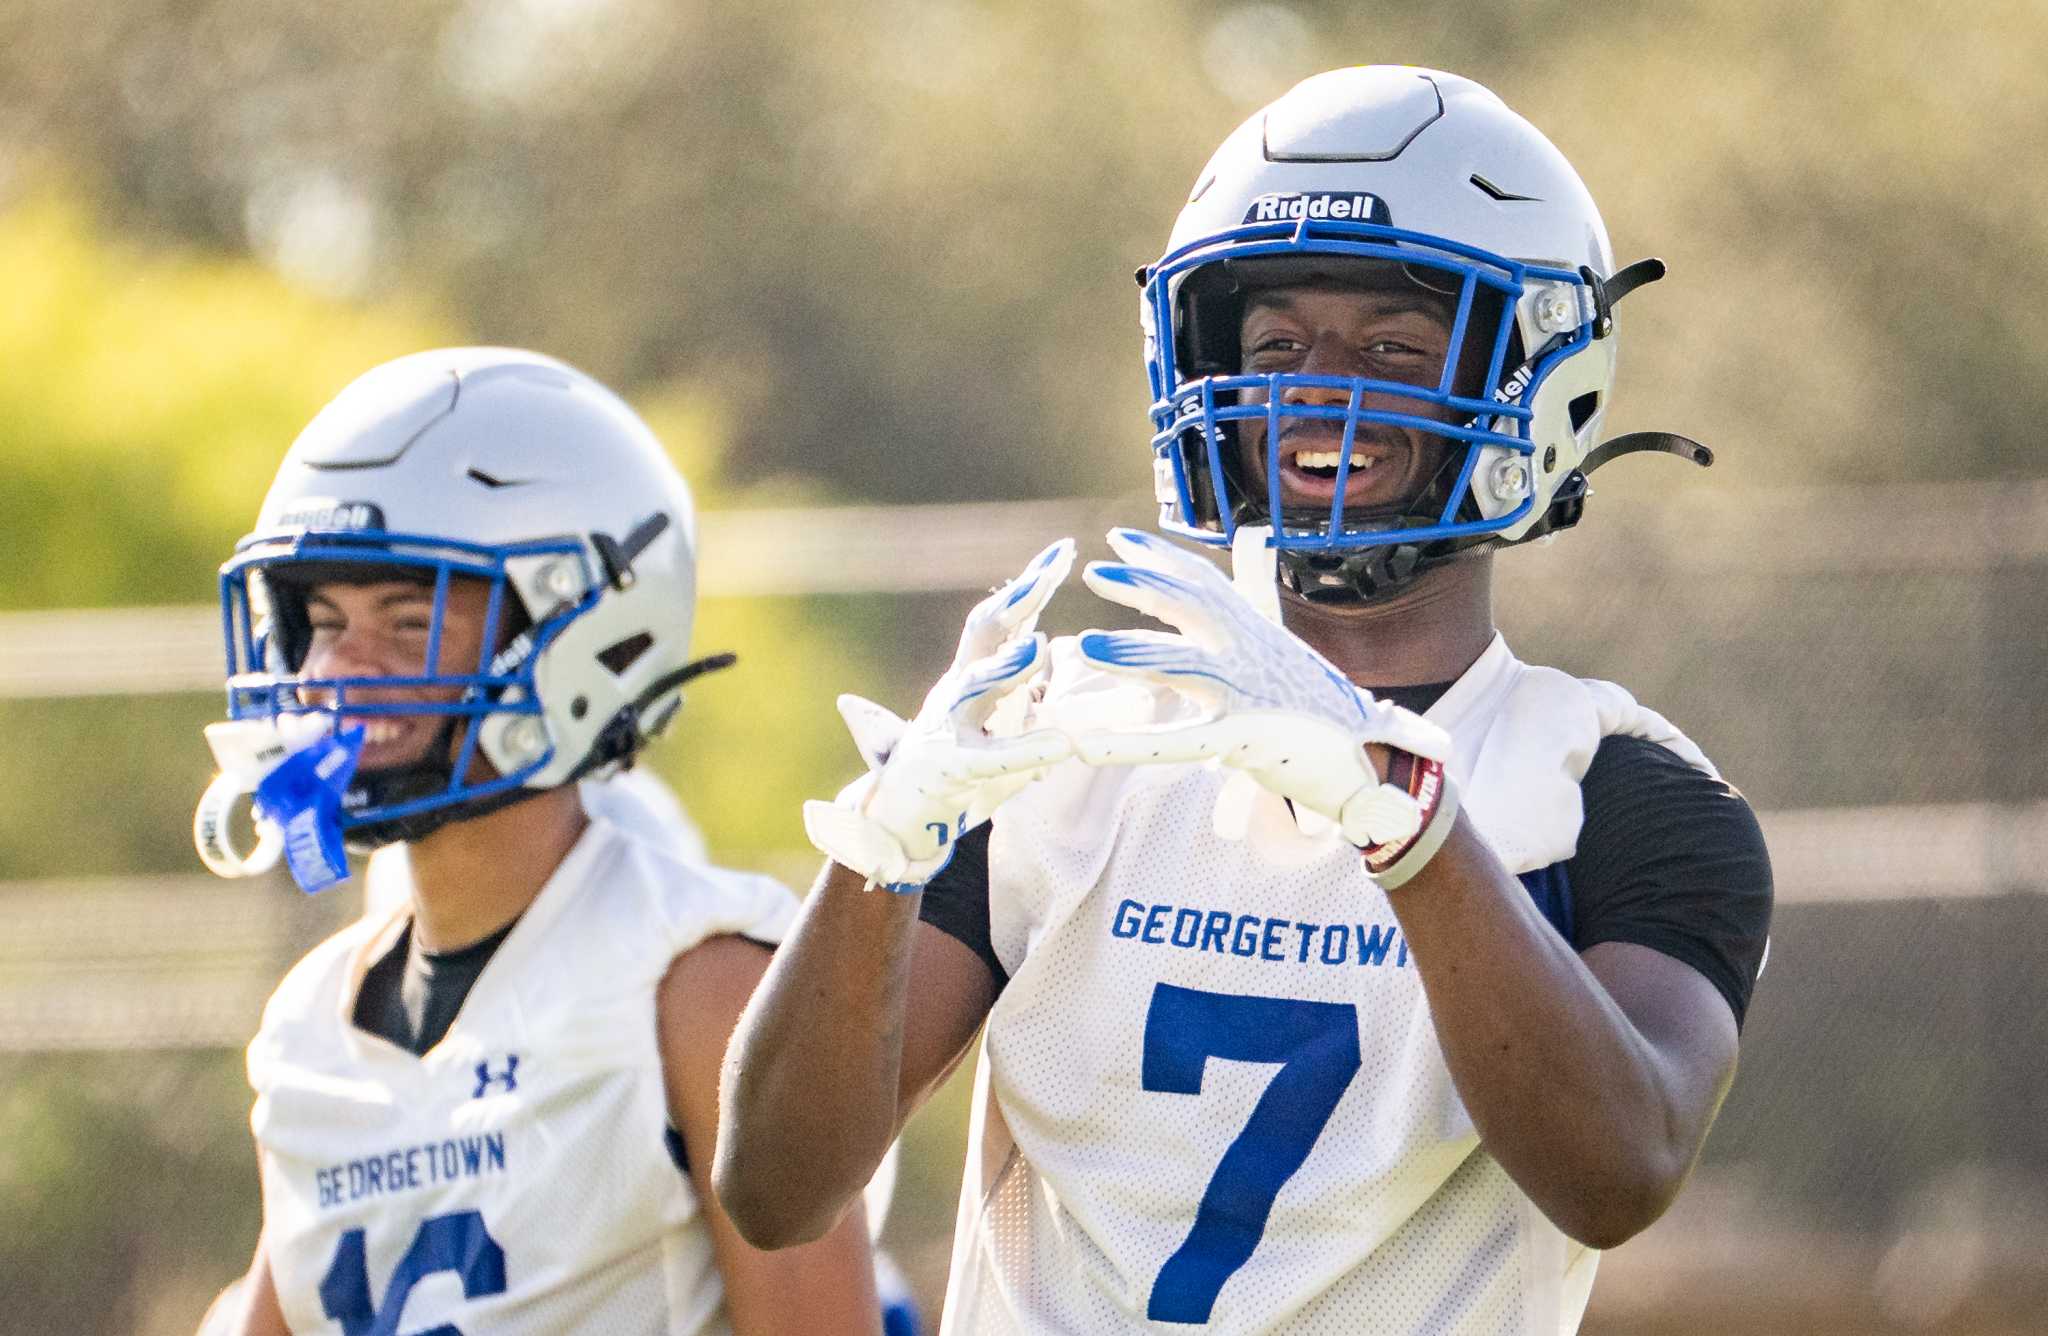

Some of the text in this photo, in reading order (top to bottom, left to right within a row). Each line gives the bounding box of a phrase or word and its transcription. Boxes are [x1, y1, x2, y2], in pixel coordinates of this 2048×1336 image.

[1256, 195, 1374, 220] Riddell
[316, 1130, 506, 1208] GEORGETOWN
[1141, 982, 1363, 1325] 7
